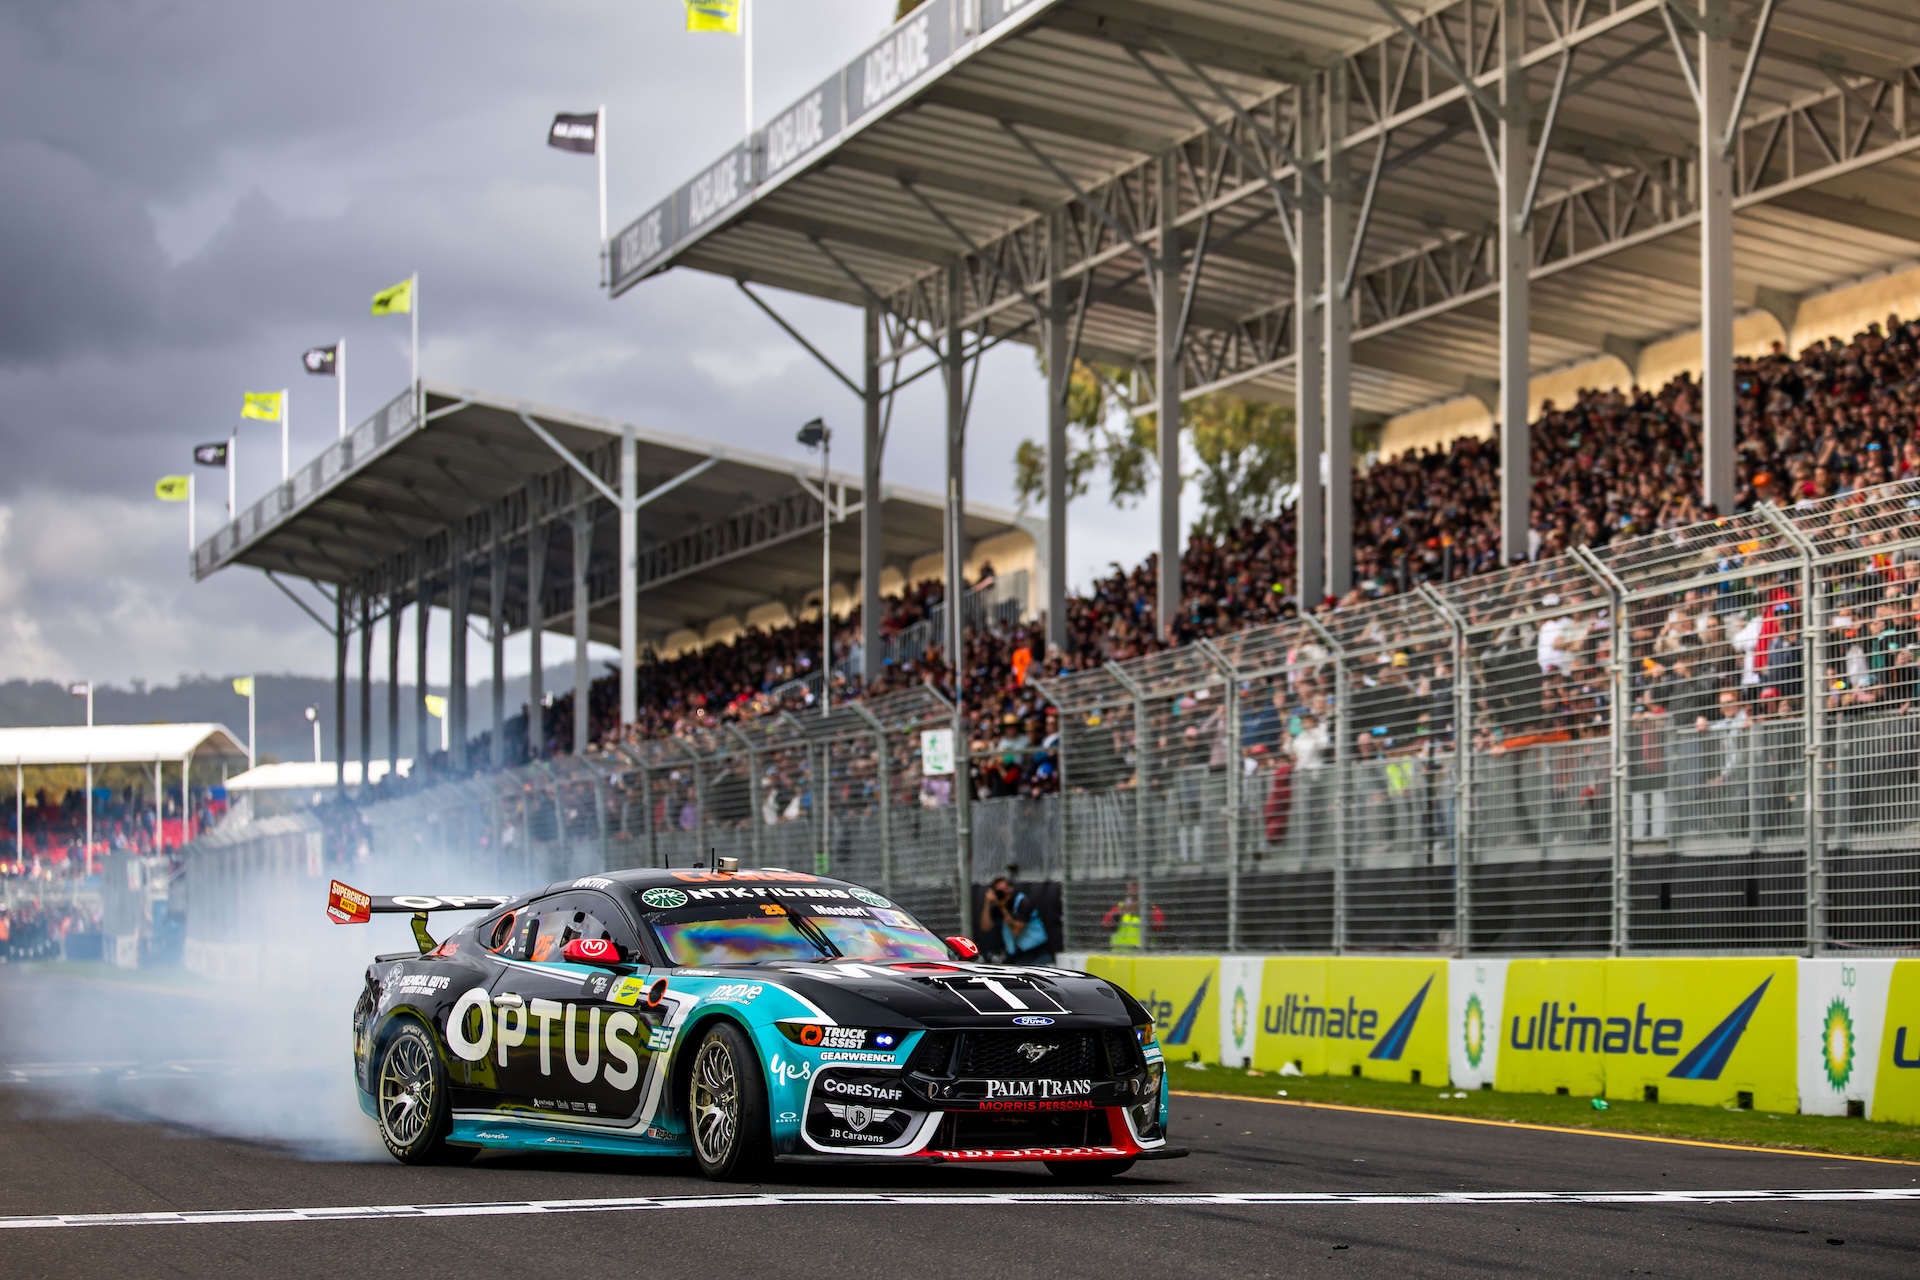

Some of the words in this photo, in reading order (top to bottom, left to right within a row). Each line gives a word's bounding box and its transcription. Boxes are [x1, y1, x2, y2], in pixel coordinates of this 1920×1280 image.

[863, 14, 929, 109] ADELAIDE
[332, 882, 370, 908] SUPERCHEAP
[648, 891, 679, 901] NTK
[687, 887, 754, 900] NTK
[751, 887, 850, 899] FILTERS
[341, 900, 356, 911] AUTO
[392, 896, 511, 909] OPT
[760, 904, 787, 915] 25
[810, 905, 870, 917] Mostert
[531, 935, 555, 962] 25
[399, 974, 430, 987] CHEMICAL
[427, 976, 451, 989] GUYS
[1842, 962, 1856, 993] bp
[709, 984, 763, 999] move
[967, 977, 1029, 1010] 1
[1264, 993, 1378, 1041] ultimate
[823, 1027, 868, 1040] TRUCK
[1511, 1001, 1683, 1056] ultimate
[446, 987, 639, 1092] OPTUS
[648, 1027, 673, 1050] 25
[820, 1037, 865, 1050] ASSIST
[820, 1051, 895, 1063] GEARWRENCH
[979, 1101, 1036, 1110] MORRIS
[1039, 1100, 1095, 1110] PERSONAL
[830, 1129, 841, 1138] JB
[842, 1131, 884, 1143] Caravans
